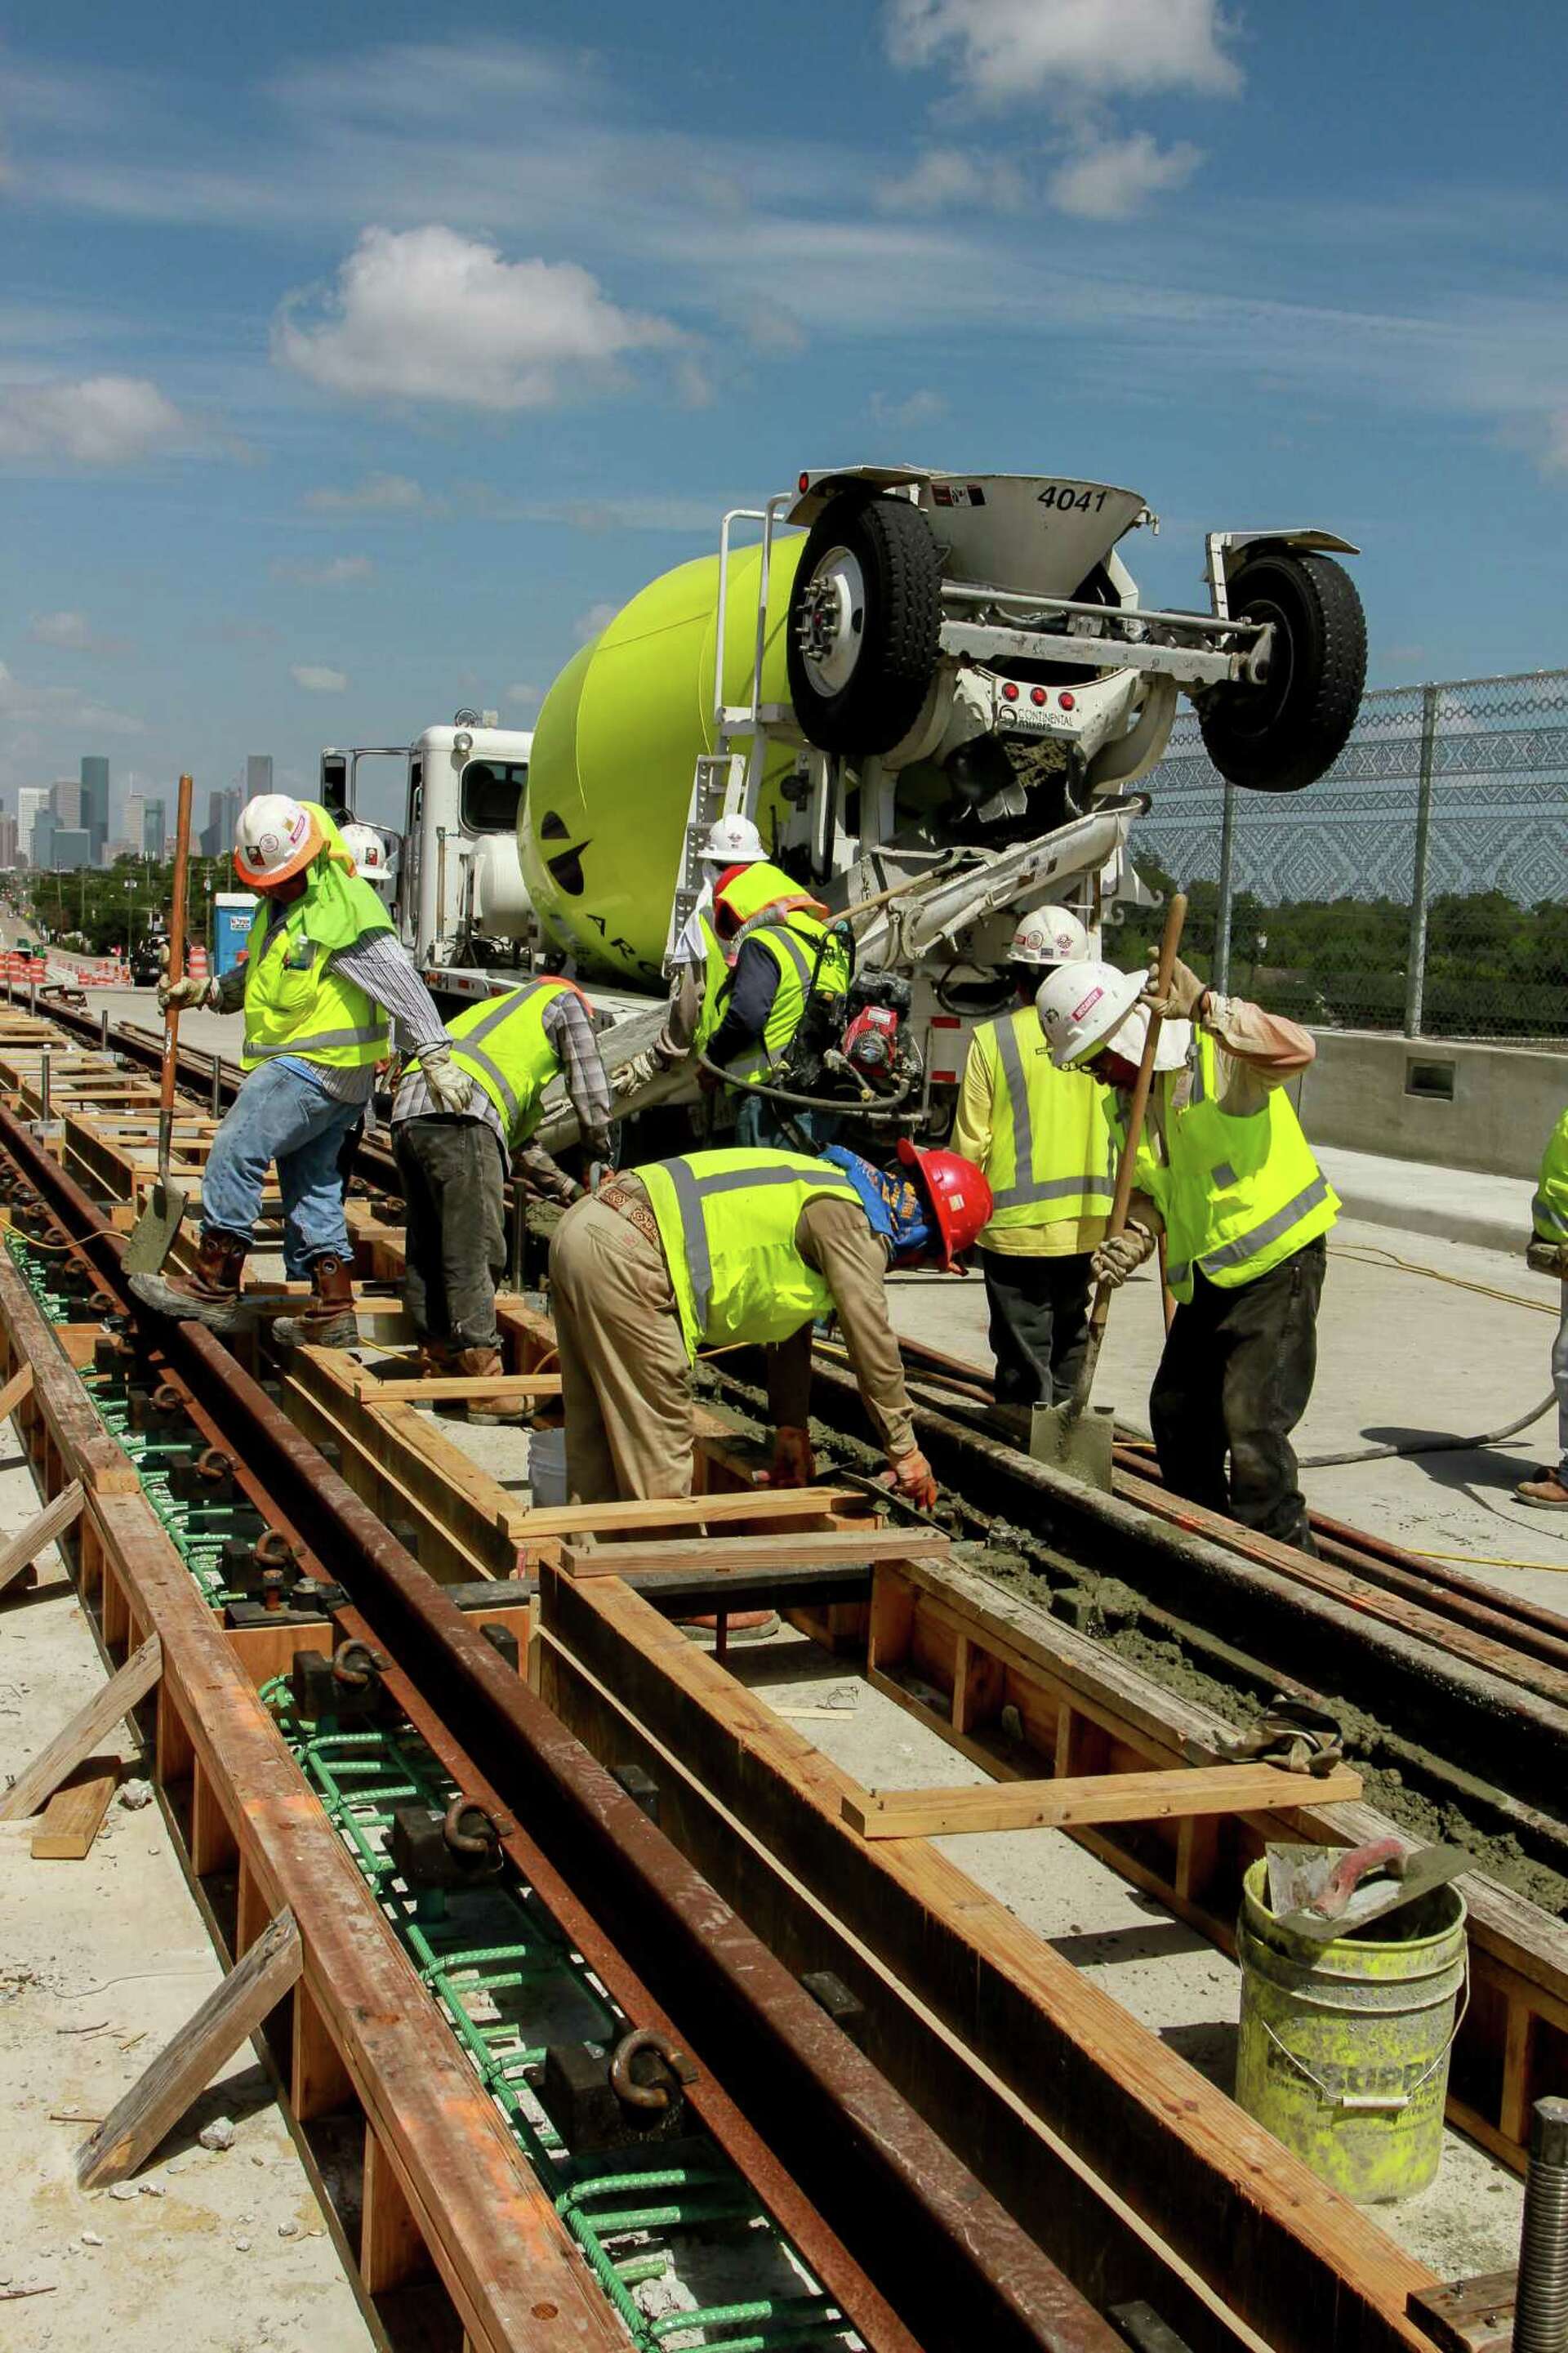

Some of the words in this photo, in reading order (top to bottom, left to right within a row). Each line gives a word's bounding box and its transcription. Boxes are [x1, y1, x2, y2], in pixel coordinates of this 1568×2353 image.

[1037, 486, 1107, 513] 4041
[1018, 709, 1074, 727] CONTINENTAL
[1018, 720, 1053, 732] mixers
